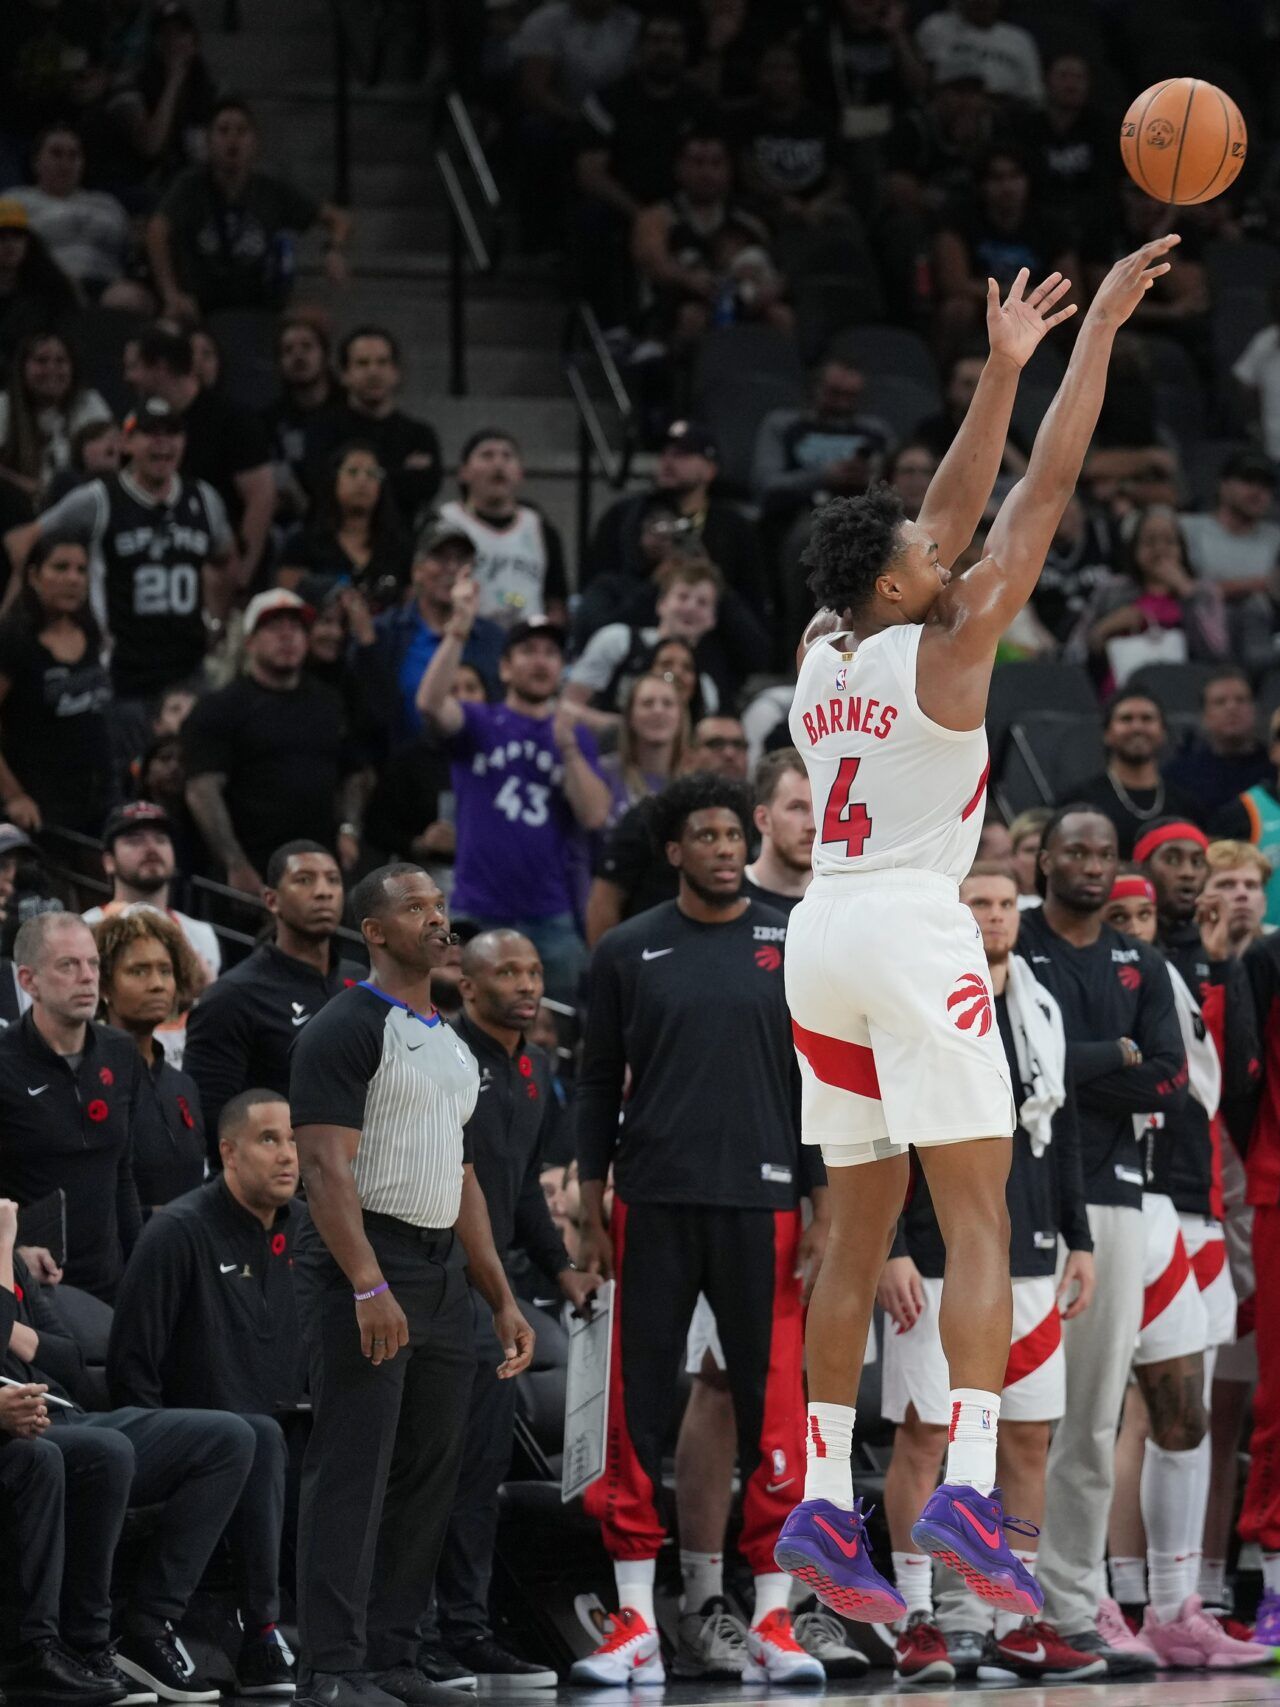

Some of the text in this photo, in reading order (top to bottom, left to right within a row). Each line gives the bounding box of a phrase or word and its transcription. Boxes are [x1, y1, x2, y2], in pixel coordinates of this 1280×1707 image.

[132, 562, 199, 616] 20
[802, 696, 898, 746] BARNES
[472, 739, 566, 787] RAPTOR
[493, 775, 552, 827] 43
[821, 757, 873, 858] 4
[752, 926, 787, 942] IBM
[1111, 948, 1141, 963] IBM
